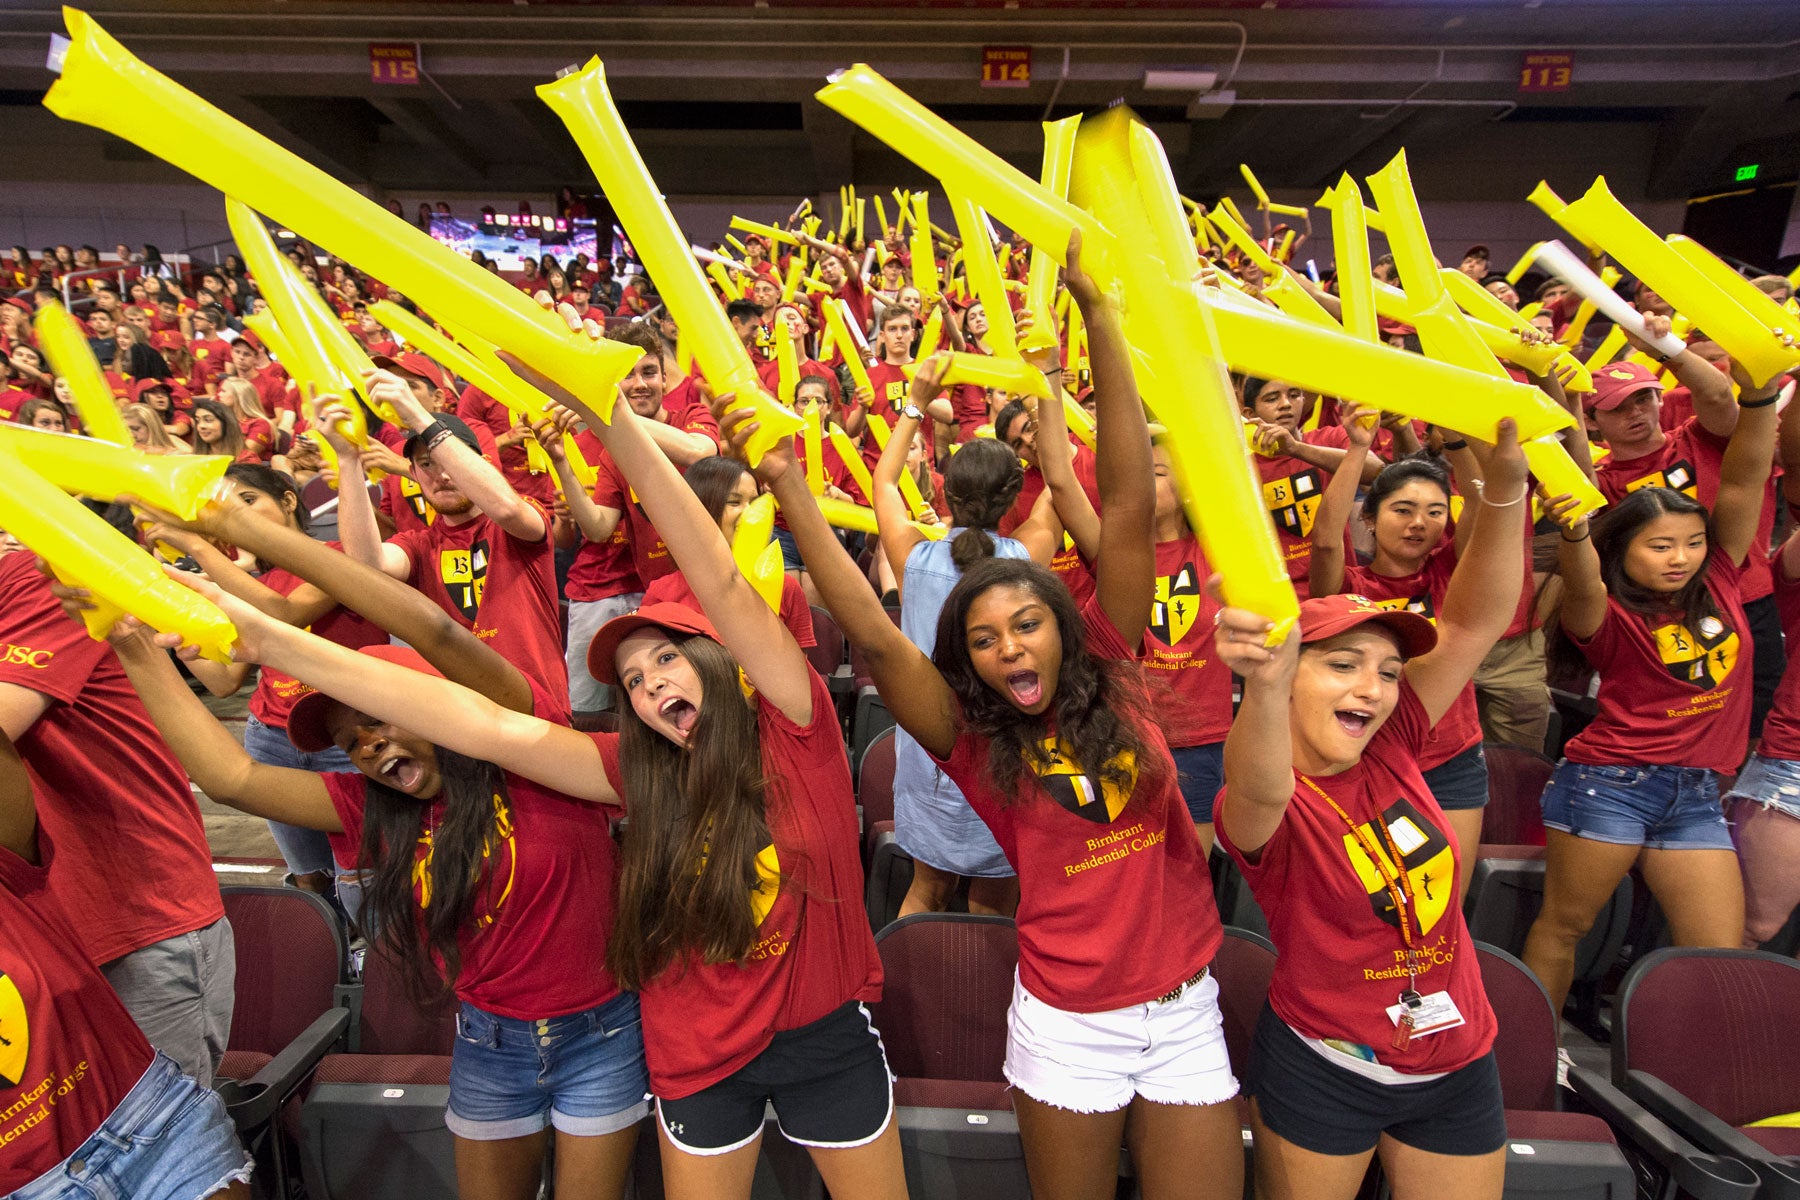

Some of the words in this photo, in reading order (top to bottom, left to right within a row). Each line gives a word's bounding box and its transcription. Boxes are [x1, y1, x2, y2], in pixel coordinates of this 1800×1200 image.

[986, 51, 1028, 60] SECTION
[372, 60, 417, 78] 115
[983, 63, 1029, 81] 114
[1521, 67, 1570, 86] 113
[1735, 164, 1759, 181] EXIT
[453, 556, 468, 576] B
[0, 643, 54, 669] USC
[1153, 649, 1193, 660] Birnkrant
[1085, 823, 1145, 852] Birnkrant
[1064, 843, 1130, 878] Residential
[1131, 827, 1166, 852] Colleg
[0, 1072, 56, 1124] irnkrant
